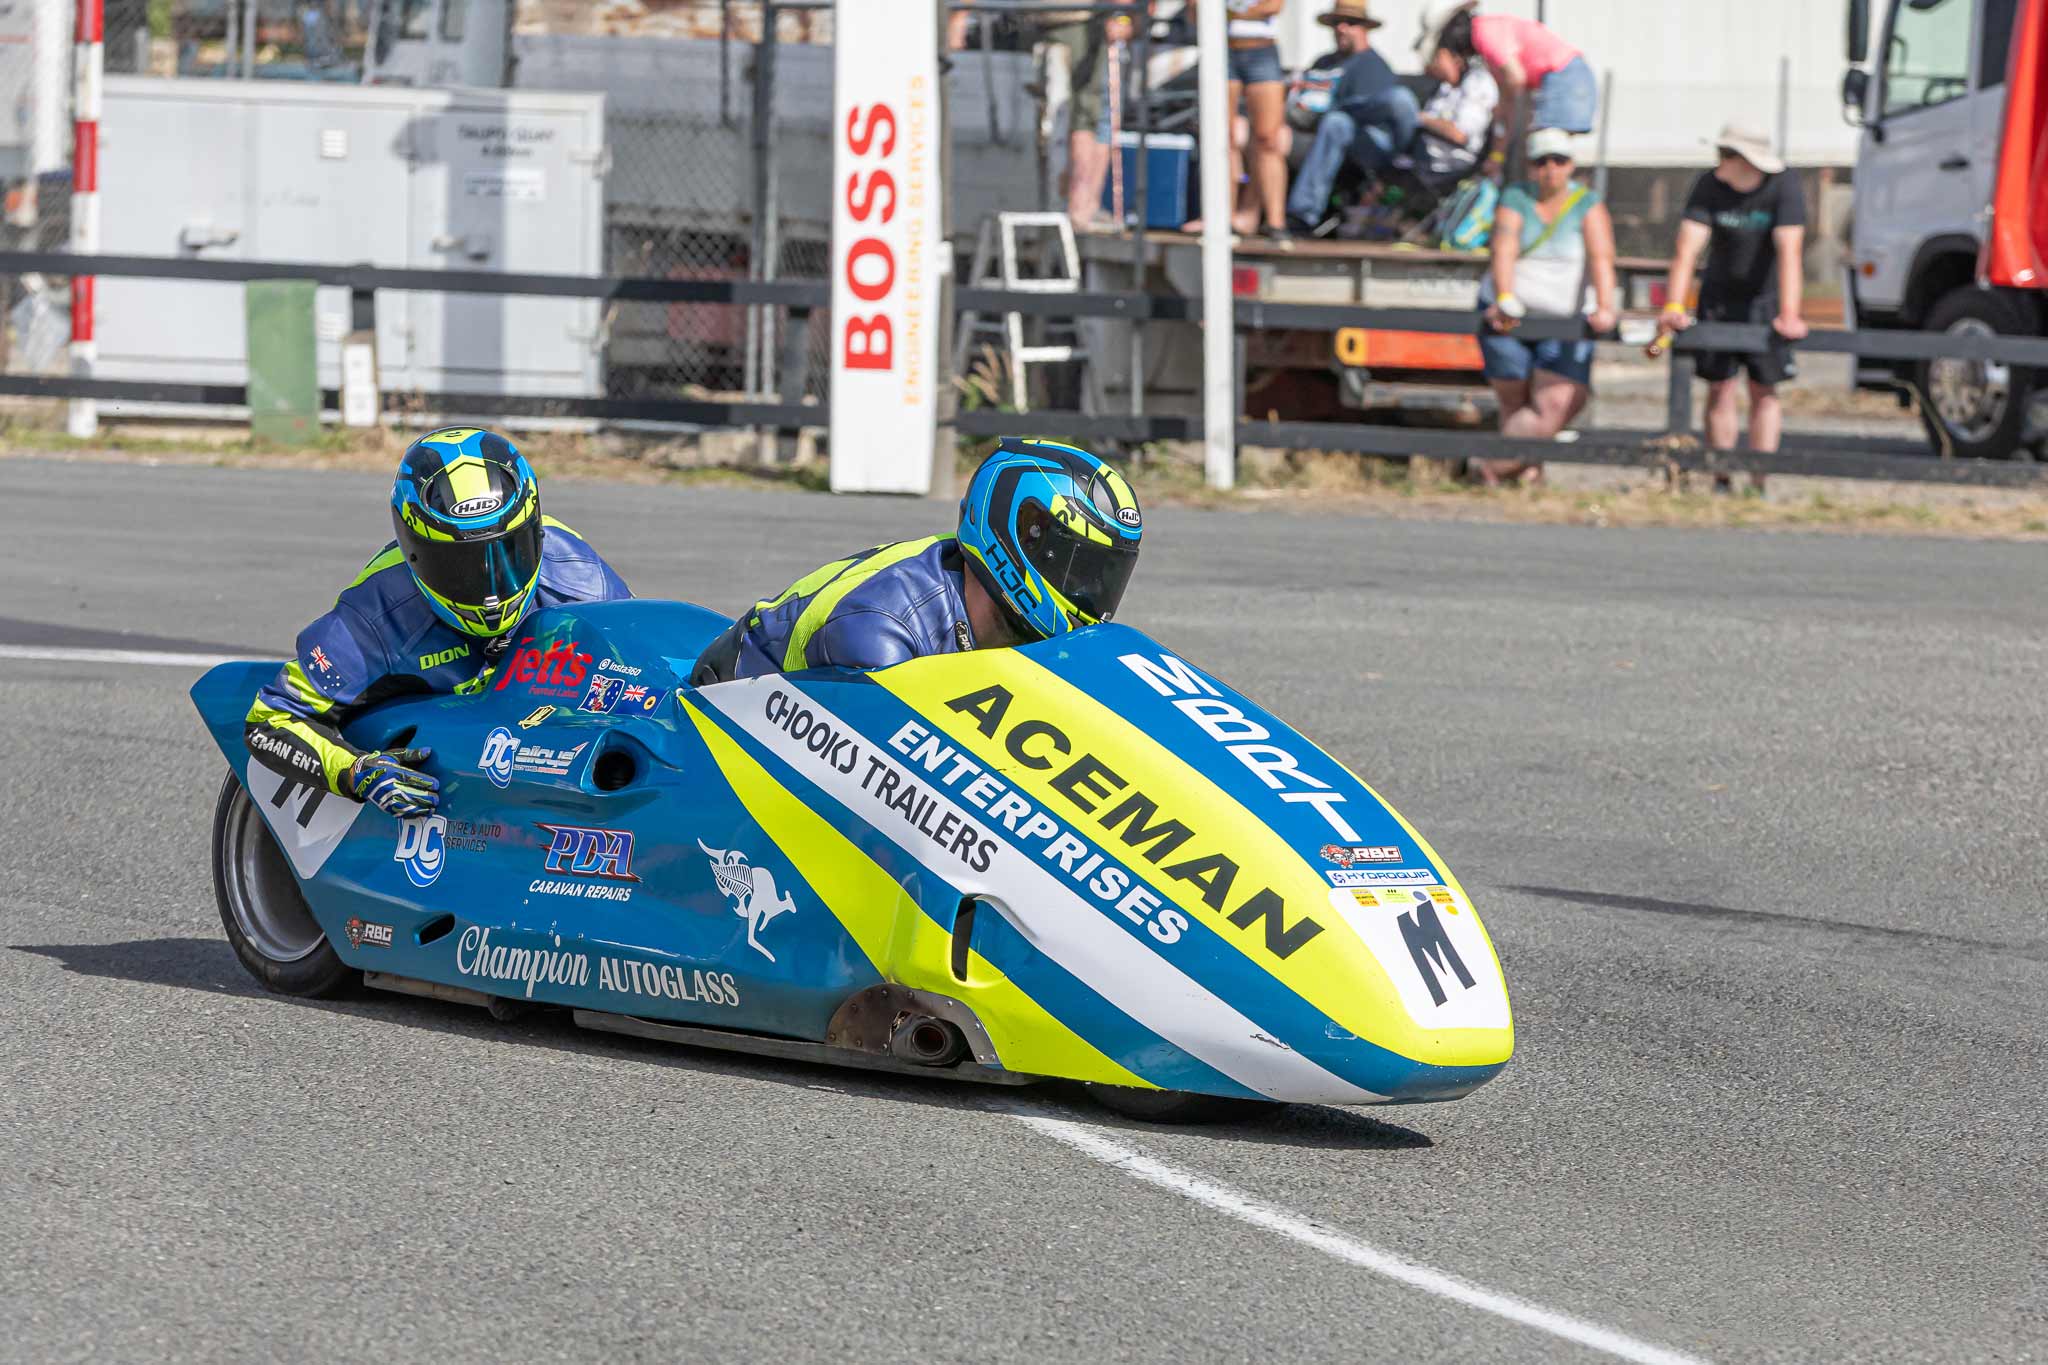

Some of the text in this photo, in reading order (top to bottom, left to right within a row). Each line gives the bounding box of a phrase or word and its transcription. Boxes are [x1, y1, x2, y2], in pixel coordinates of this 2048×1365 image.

[844, 103, 896, 370] BOSS
[457, 499, 494, 515] HJC
[1119, 512, 1140, 524] HJC
[985, 543, 1037, 614] HJC
[419, 643, 470, 671] DION
[495, 637, 593, 691] jetts
[609, 661, 642, 677] Insta360
[292, 750, 321, 777] ENT.
[479, 736, 521, 771] DC
[1116, 653, 1362, 842] MBRT
[765, 690, 999, 873] CHOOKS TRAILERS
[395, 815, 447, 863] DC
[480, 823, 502, 838] AUTO
[887, 719, 1189, 945] ENTERPRISES
[944, 684, 1325, 960] ACEMAN
[446, 836, 487, 852] SERVICES
[541, 827, 637, 879] PDA
[1352, 847, 1400, 859] RBG
[529, 879, 631, 902] CARAVAN REPAIRS
[1345, 871, 1430, 880] HYDROQUIP
[364, 923, 393, 941] RBG
[456, 925, 740, 1007] Champion AUTOGLASS
[1397, 900, 1476, 1008] M
